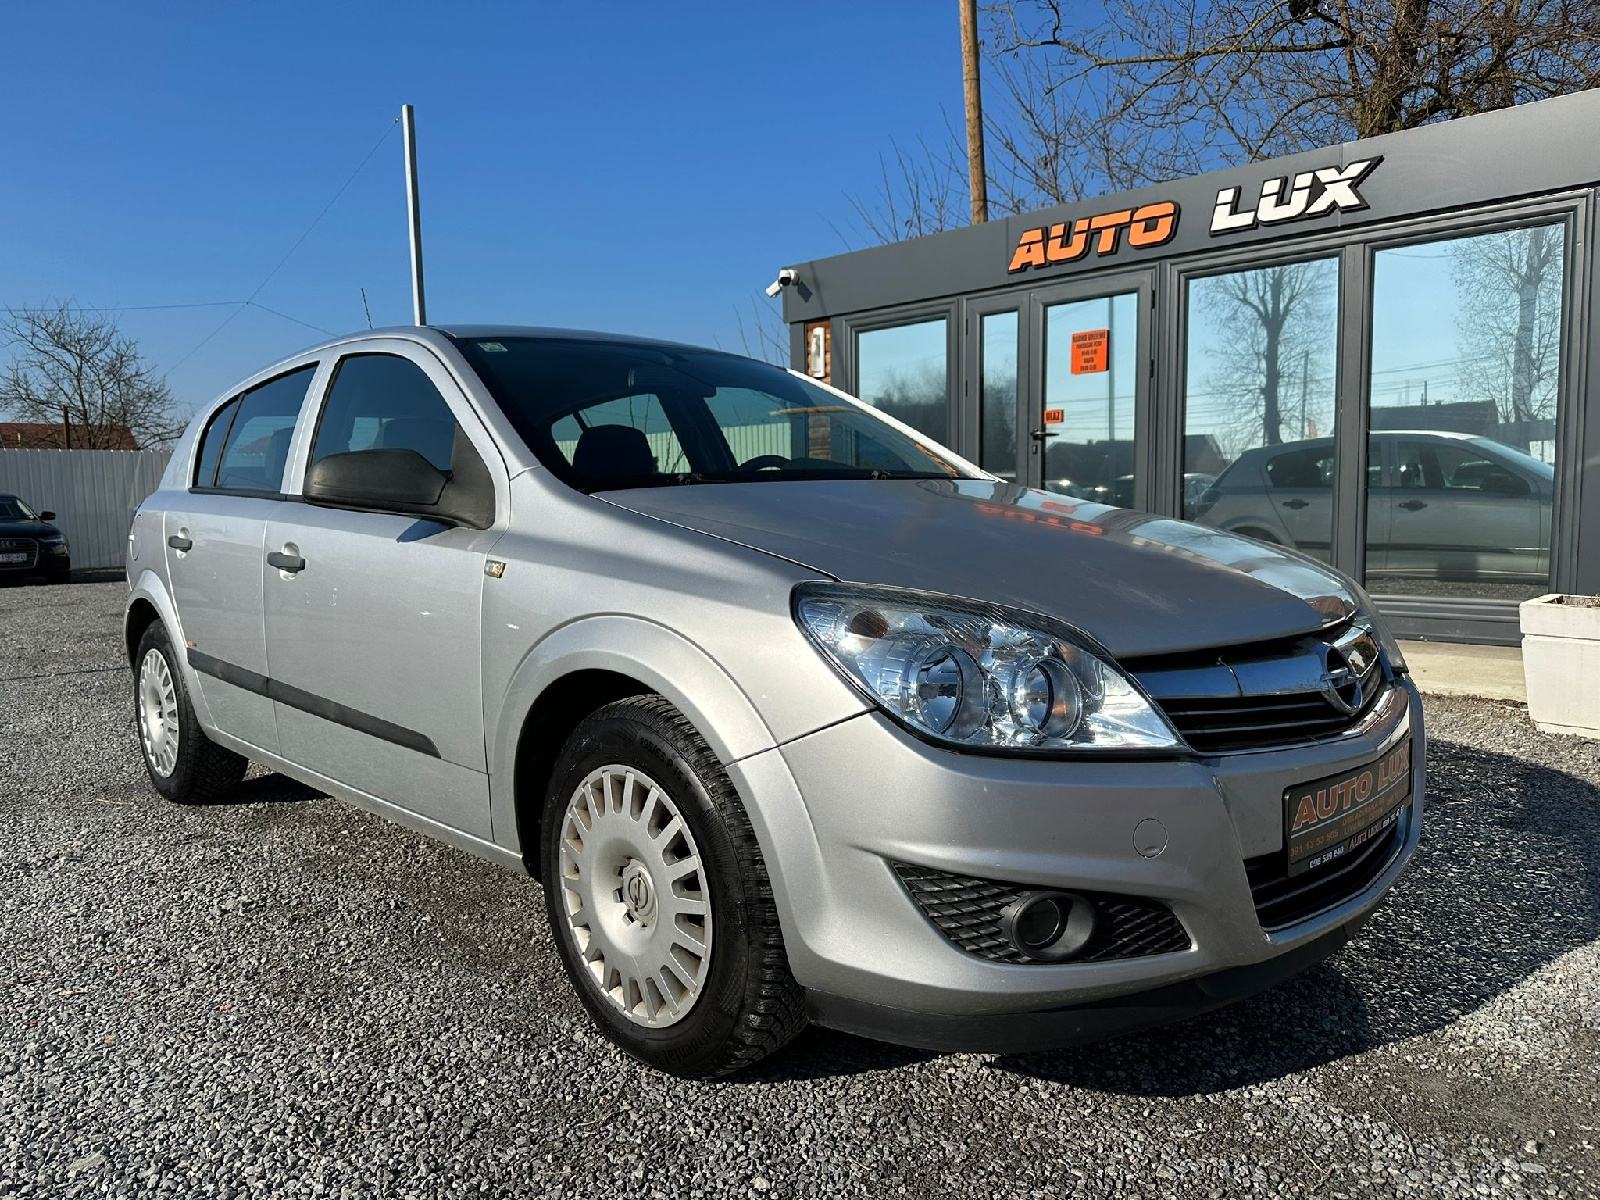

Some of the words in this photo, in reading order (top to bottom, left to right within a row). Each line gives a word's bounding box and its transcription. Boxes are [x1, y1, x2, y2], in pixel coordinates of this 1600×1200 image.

[1008, 201, 1179, 272] AUTO
[1210, 156, 1381, 235] LUX
[1291, 770, 1373, 831] AUTO
[1378, 743, 1410, 790] LUX
